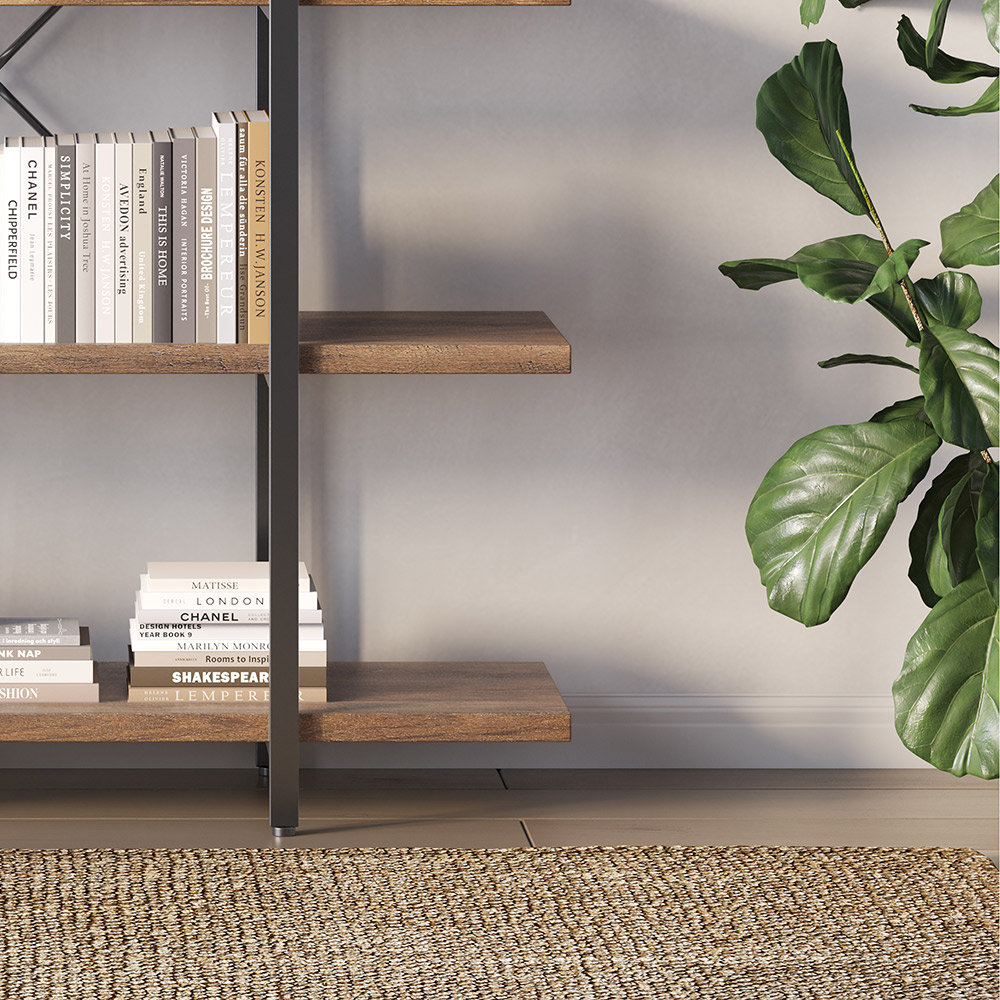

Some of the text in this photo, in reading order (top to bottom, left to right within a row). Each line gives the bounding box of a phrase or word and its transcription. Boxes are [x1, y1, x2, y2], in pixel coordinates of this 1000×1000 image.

[239, 157, 247, 171] für
[239, 174, 247, 193] alla
[27, 160, 37, 220] CHANEL
[60, 156, 70, 240] SIMPLICITY
[102, 176, 111, 232] KONSTEN
[136, 168, 147, 214] England
[239, 195, 247, 211] die
[255, 160, 265, 223] KONSTEN
[81, 162, 91, 273] At Home in Joshua Tree
[117, 183, 129, 295] AVEDON advertising
[200, 188, 213, 280] BROCHURE DESIGN
[239, 213, 247, 257] sünderin
[8, 200, 18, 280] CHIPPERFIELD
[158, 205, 167, 286] THIS IS HOME
[220, 172, 233, 316] LEMPEREUR
[136, 251, 146, 324] United Kingdom
[191, 581, 239, 590] MATISSE
[196, 597, 264, 605] LONDON
[180, 612, 239, 621] CHANEL
[18, 649, 41, 658] NAP
[177, 642, 229, 650] MARILYN
[205, 655, 235, 663] Rooms
[237, 655, 246, 663] to
[5, 667, 25, 677] LIFE
[172, 671, 270, 683] SHAKESPEAR
[175, 690, 304, 701] LEMPERER
